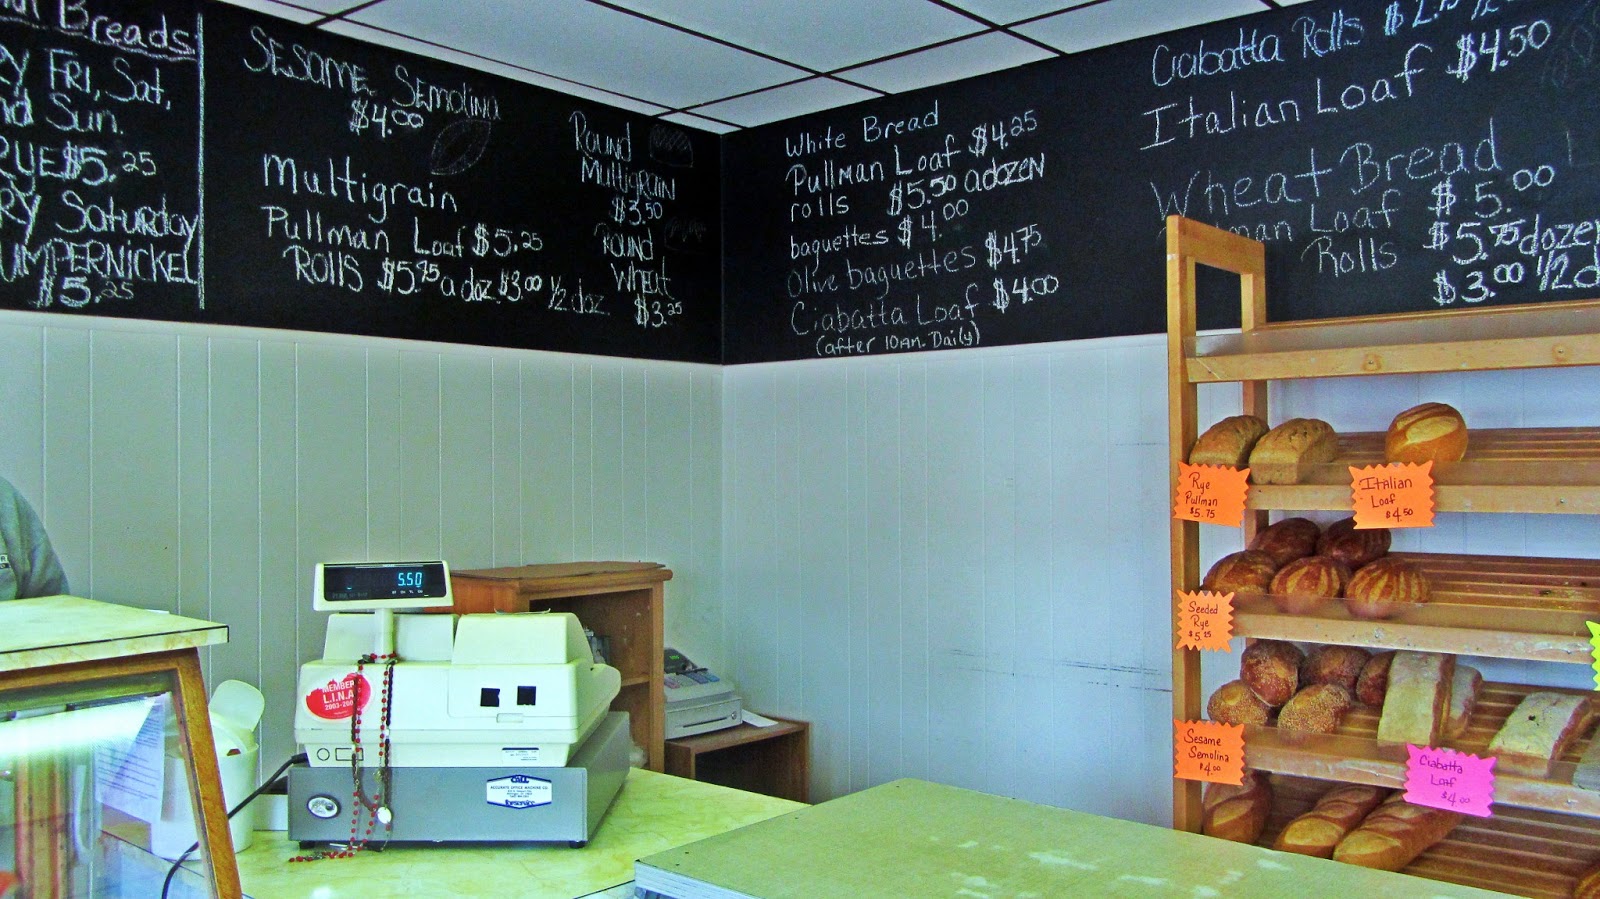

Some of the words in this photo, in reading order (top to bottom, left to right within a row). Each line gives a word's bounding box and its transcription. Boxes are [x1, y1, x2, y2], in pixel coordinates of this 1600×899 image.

[59, 0, 195, 55] Breads
[1152, 27, 1284, 86] Ciabatta
[1292, 9, 1365, 58] Rolls
[1140, 90, 1301, 151] Italian
[1317, 43, 1433, 114] Loaf
[1445, 20, 1552, 82] $4.50
[46, 92, 124, 134] Sun.
[349, 97, 424, 138] $4.00
[785, 126, 847, 157] White
[862, 99, 938, 142] Bread
[785, 160, 884, 195] Pullman
[893, 134, 961, 175] Loaf
[968, 109, 1038, 157] $4.25
[1150, 147, 1333, 220] Wheat
[1339, 117, 1502, 195] Bread
[263, 153, 457, 224] Multigrain
[790, 192, 850, 222] rolls
[886, 174, 957, 216] $5.50
[1310, 188, 1401, 232] Loaf
[1427, 165, 1555, 219] $5.00
[610, 197, 663, 226] $3.50
[260, 206, 389, 253] Pullman
[413, 216, 466, 257] Loaf
[471, 222, 543, 258] $5.25
[790, 225, 890, 276] baguettes
[897, 199, 969, 249] $4.00
[787, 266, 839, 298] Olive
[846, 245, 976, 300] baguettes
[985, 224, 1042, 270] $4.75
[1300, 235, 1398, 277] Rolls
[377, 257, 440, 294] $5.75
[440, 276, 456, 296] a
[1432, 262, 1526, 306] $3.00
[634, 294, 683, 329] $3.25
[791, 301, 907, 336] Ciabatta
[917, 282, 980, 326] Loaf
[988, 274, 1060, 314] $4.00
[815, 336, 876, 356] (after
[1185, 490, 1218, 507] Pullman
[1189, 471, 1211, 495] Rye
[1358, 475, 1413, 490] Italian
[1370, 493, 1396, 509] Loaf
[1190, 506, 1216, 519] $5.75
[1385, 507, 1414, 523] $4.50
[397, 571, 424, 588] 5.50
[1188, 600, 1219, 615] Seeded
[1190, 614, 1210, 631] Rye
[1184, 728, 1222, 747] Sesame
[1188, 745, 1230, 763] Semolina
[1199, 762, 1221, 777] $4.00
[1419, 754, 1463, 775] Ciabatta
[1430, 773, 1457, 788] Loaf
[1441, 791, 1471, 807] $4.00
